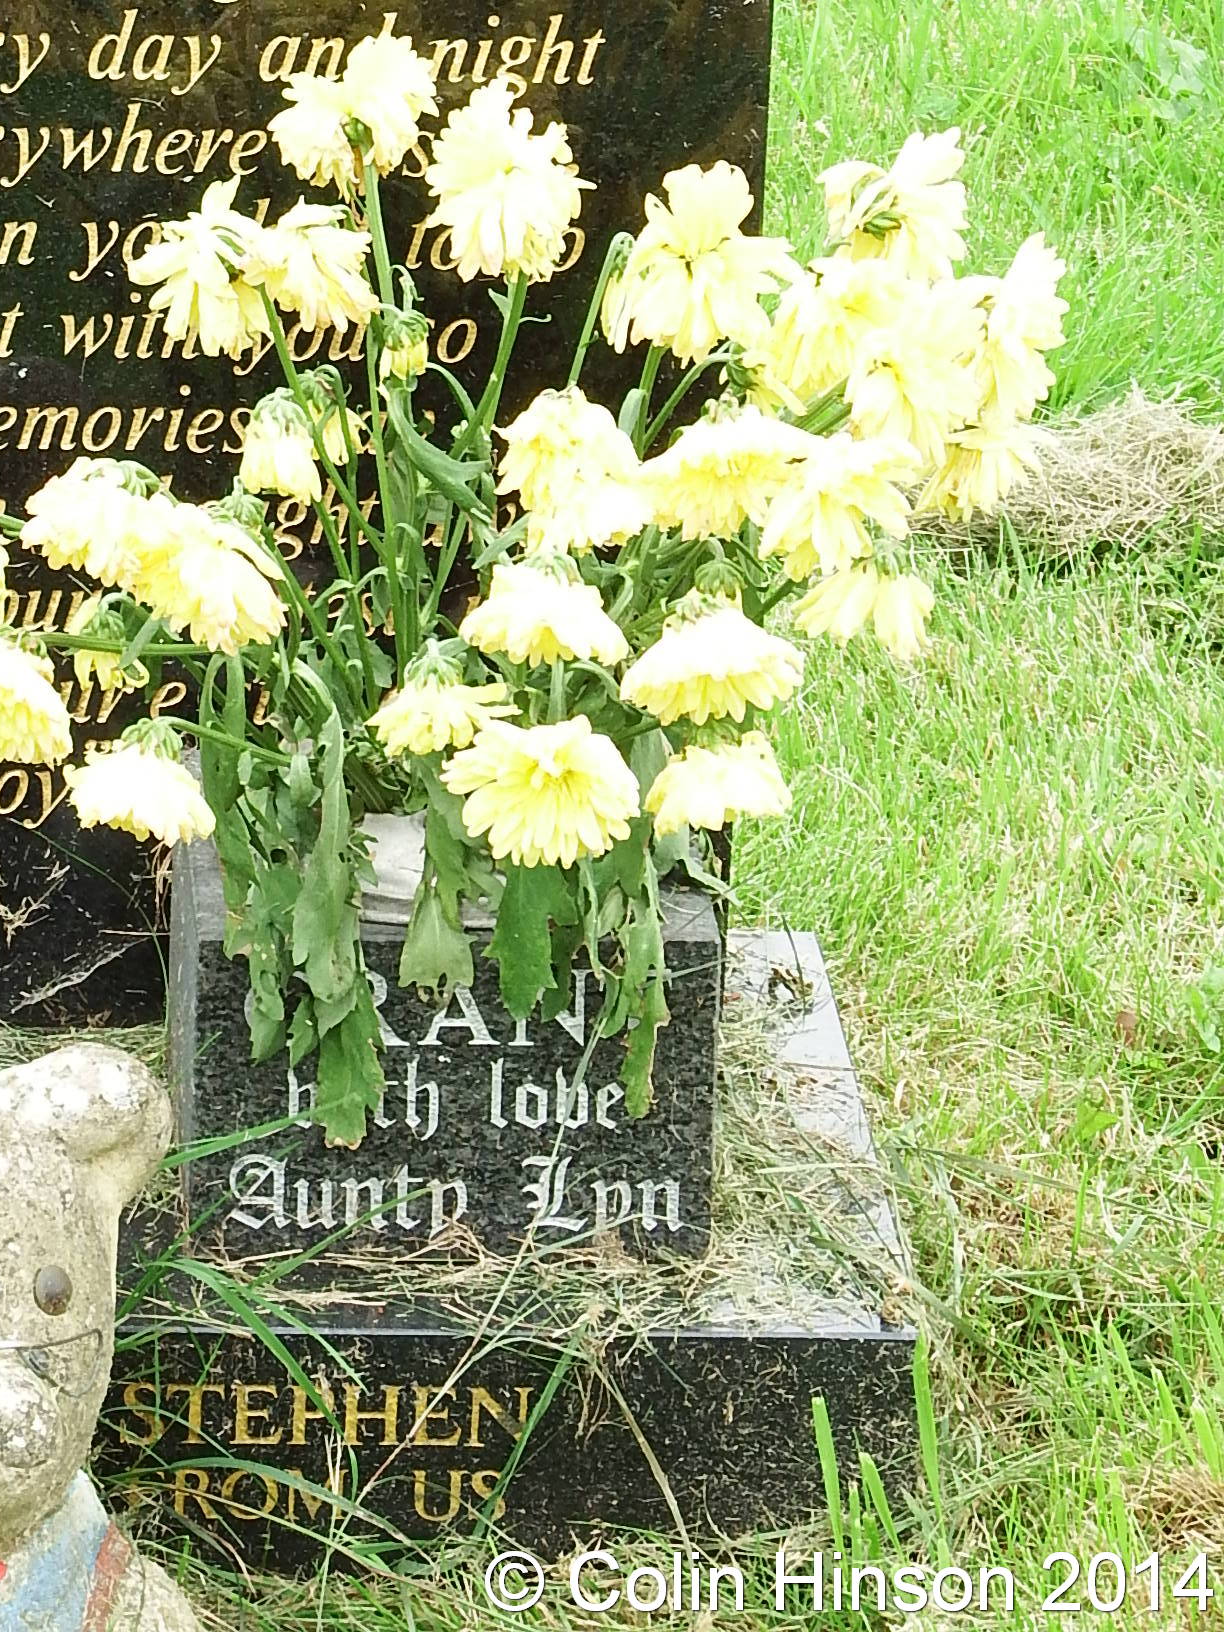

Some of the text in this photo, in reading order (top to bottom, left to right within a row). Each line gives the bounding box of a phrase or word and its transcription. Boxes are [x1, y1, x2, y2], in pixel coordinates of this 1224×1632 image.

[87, 8, 222, 96] day
[428, 13, 607, 100] night
[490, 1056, 625, 1130] love
[224, 1149, 686, 1242] Aunty Lyn
[119, 1380, 535, 1449] STEPHEN
[413, 1469, 507, 1522] US
